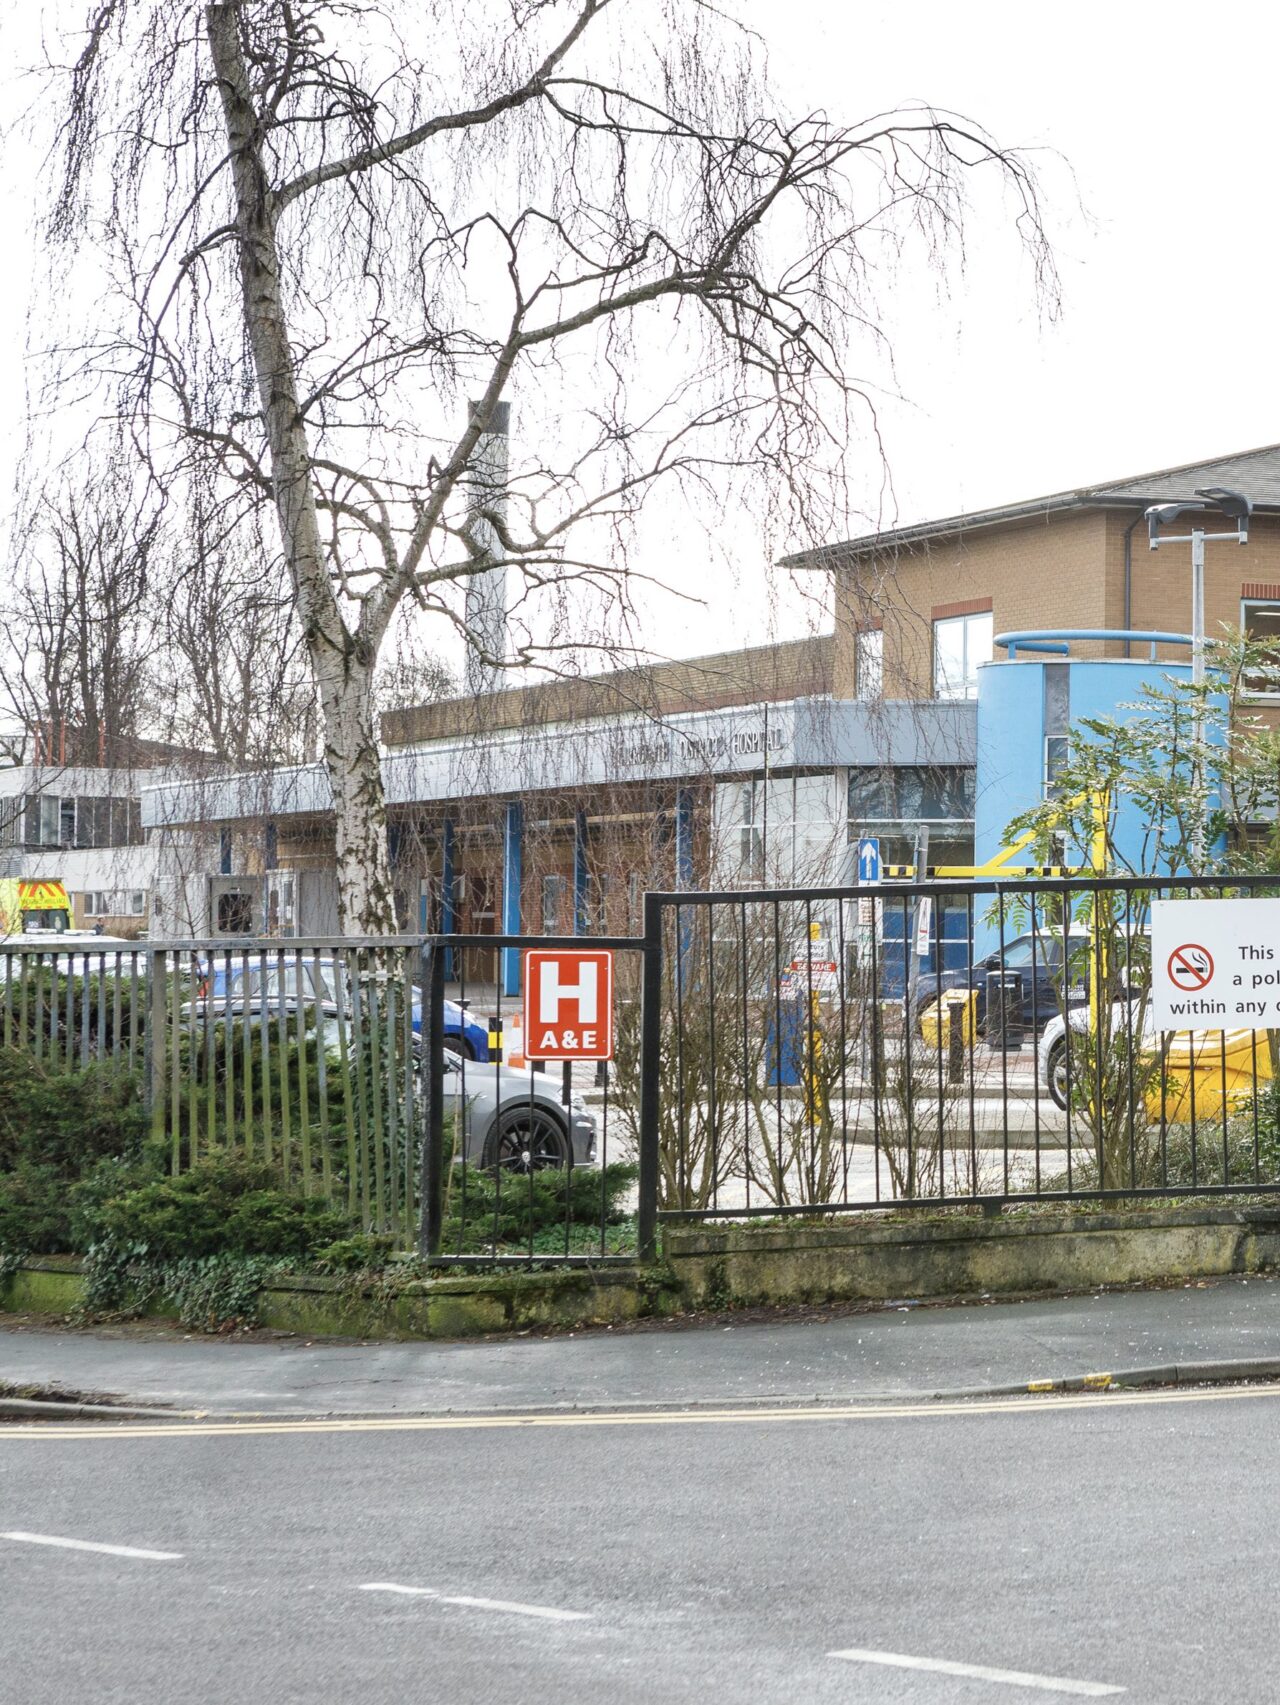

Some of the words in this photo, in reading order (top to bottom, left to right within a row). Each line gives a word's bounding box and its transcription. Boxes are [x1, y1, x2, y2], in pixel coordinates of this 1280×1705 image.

[1238, 945, 1274, 960] This
[1233, 974, 1242, 986] a
[540, 961, 598, 1024] H
[1170, 998, 1226, 1015] within
[1235, 1001, 1267, 1017] any
[540, 1030, 598, 1049] A&E
